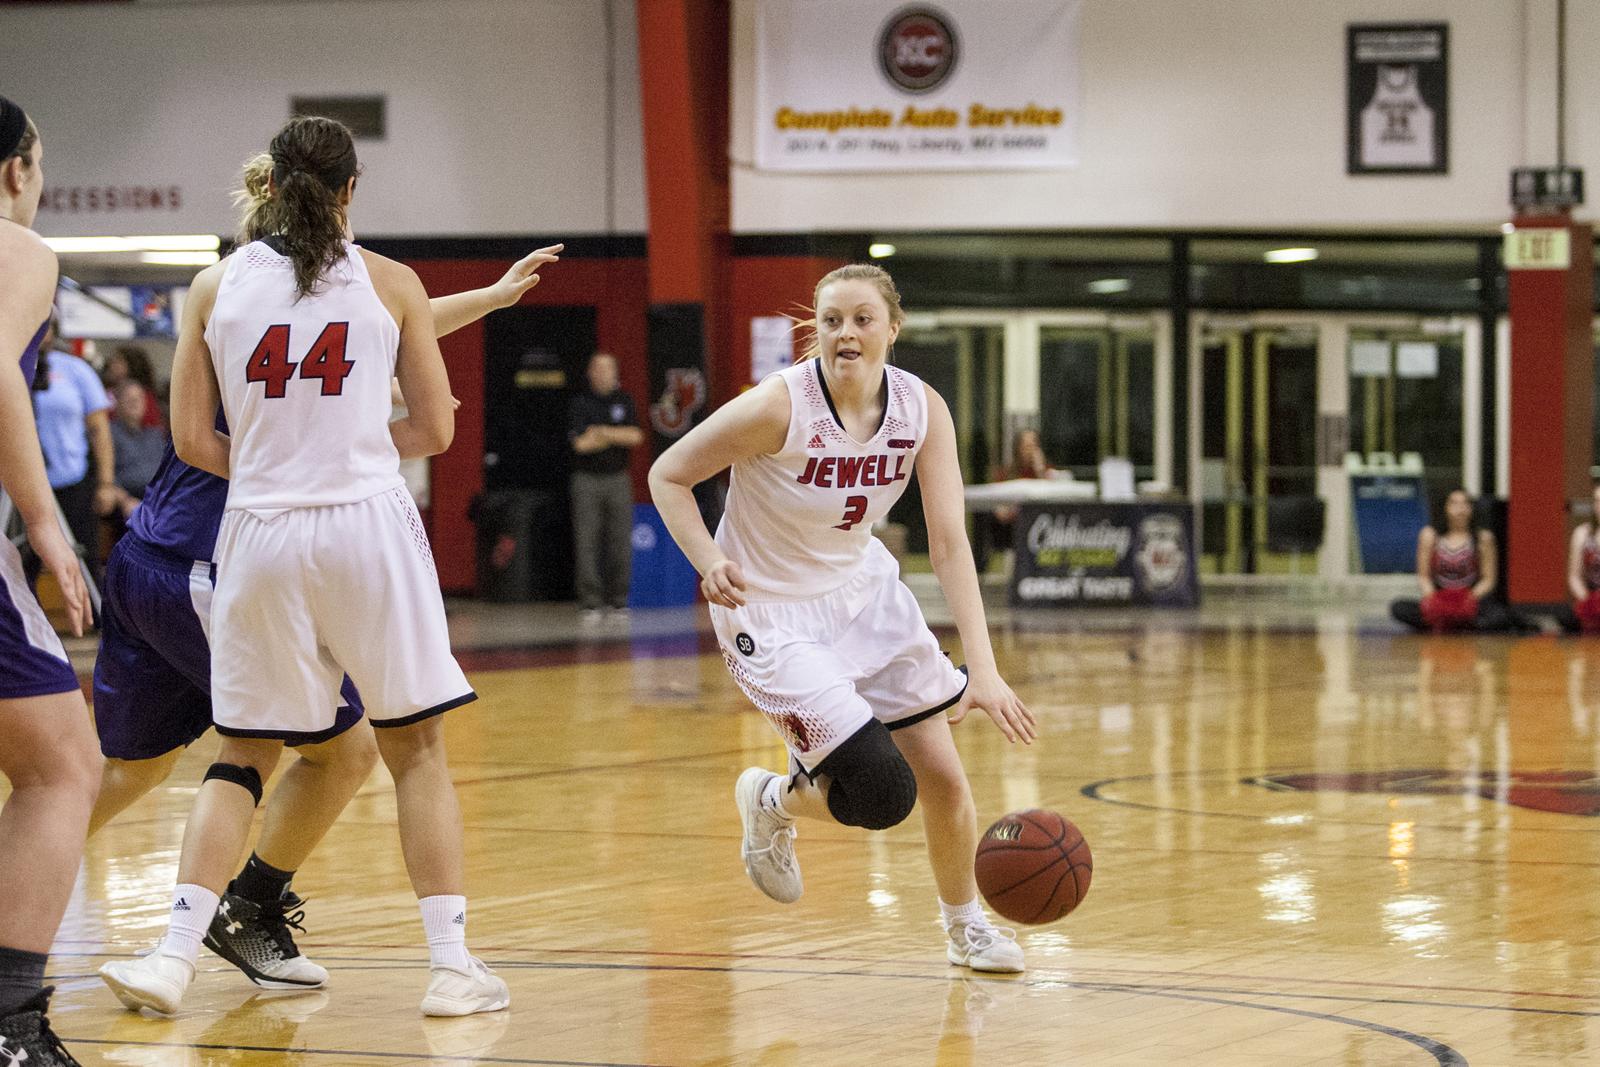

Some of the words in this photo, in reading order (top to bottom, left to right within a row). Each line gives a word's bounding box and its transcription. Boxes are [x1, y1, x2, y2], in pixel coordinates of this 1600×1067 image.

[776, 106, 892, 132] Complete
[900, 105, 959, 128] Auto
[968, 102, 1063, 128] Service
[246, 321, 356, 399] 44
[796, 455, 906, 489] JEWELL
[739, 637, 751, 651] SB
